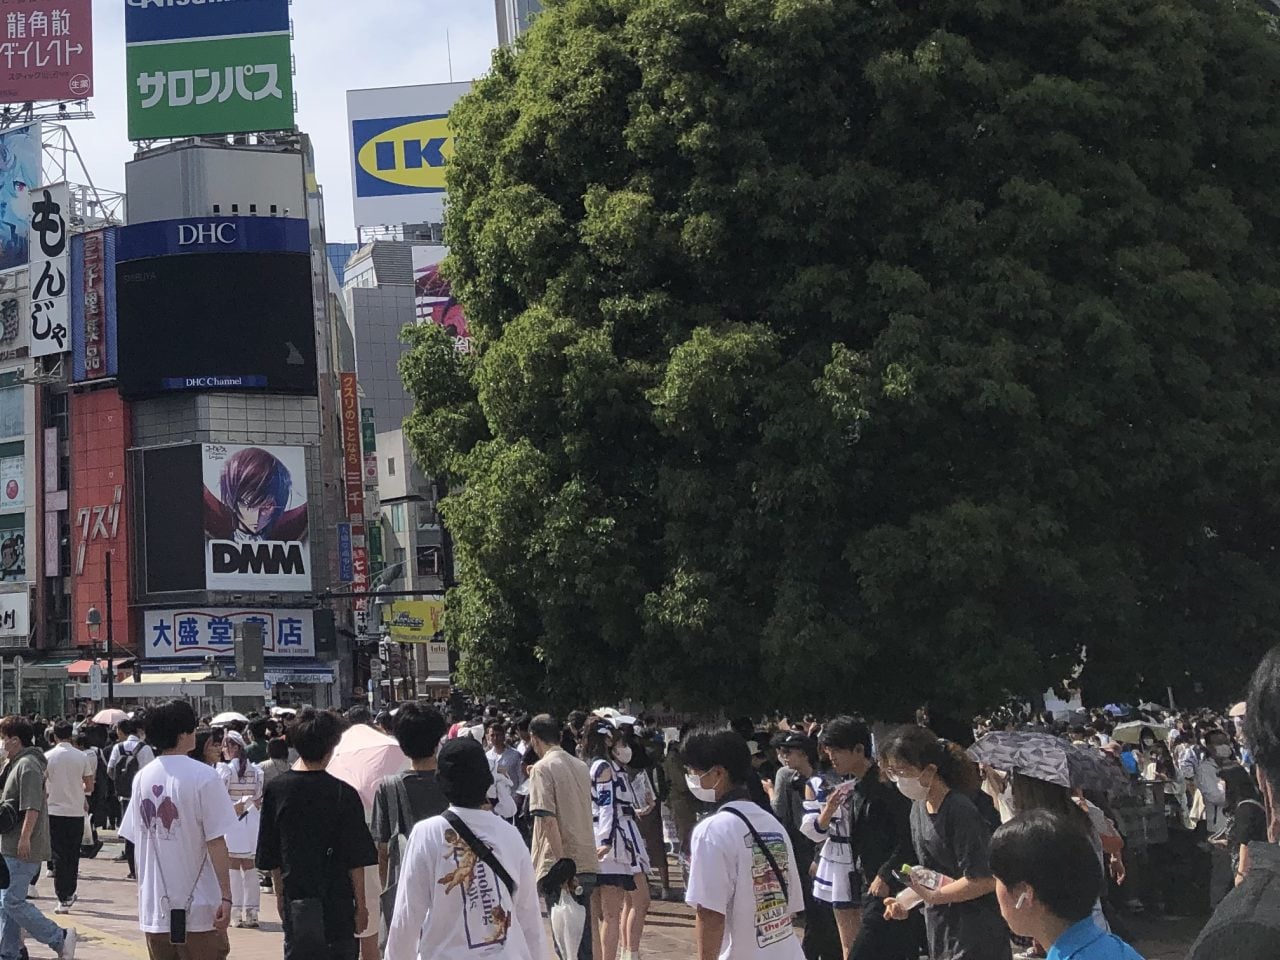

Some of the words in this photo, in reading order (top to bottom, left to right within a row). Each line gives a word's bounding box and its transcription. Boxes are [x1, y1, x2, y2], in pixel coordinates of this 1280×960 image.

[7, 8, 71, 39] 龍角散
[136, 63, 283, 109] サロンパス
[375, 137, 449, 171] IK
[178, 223, 236, 245] DHC
[31, 189, 67, 349] もんじゃ
[186, 378, 206, 387] DHC
[207, 377, 242, 386] Channel
[75, 484, 123, 575] クスリ
[211, 543, 305, 575] DMM
[476, 863, 496, 926] moking
